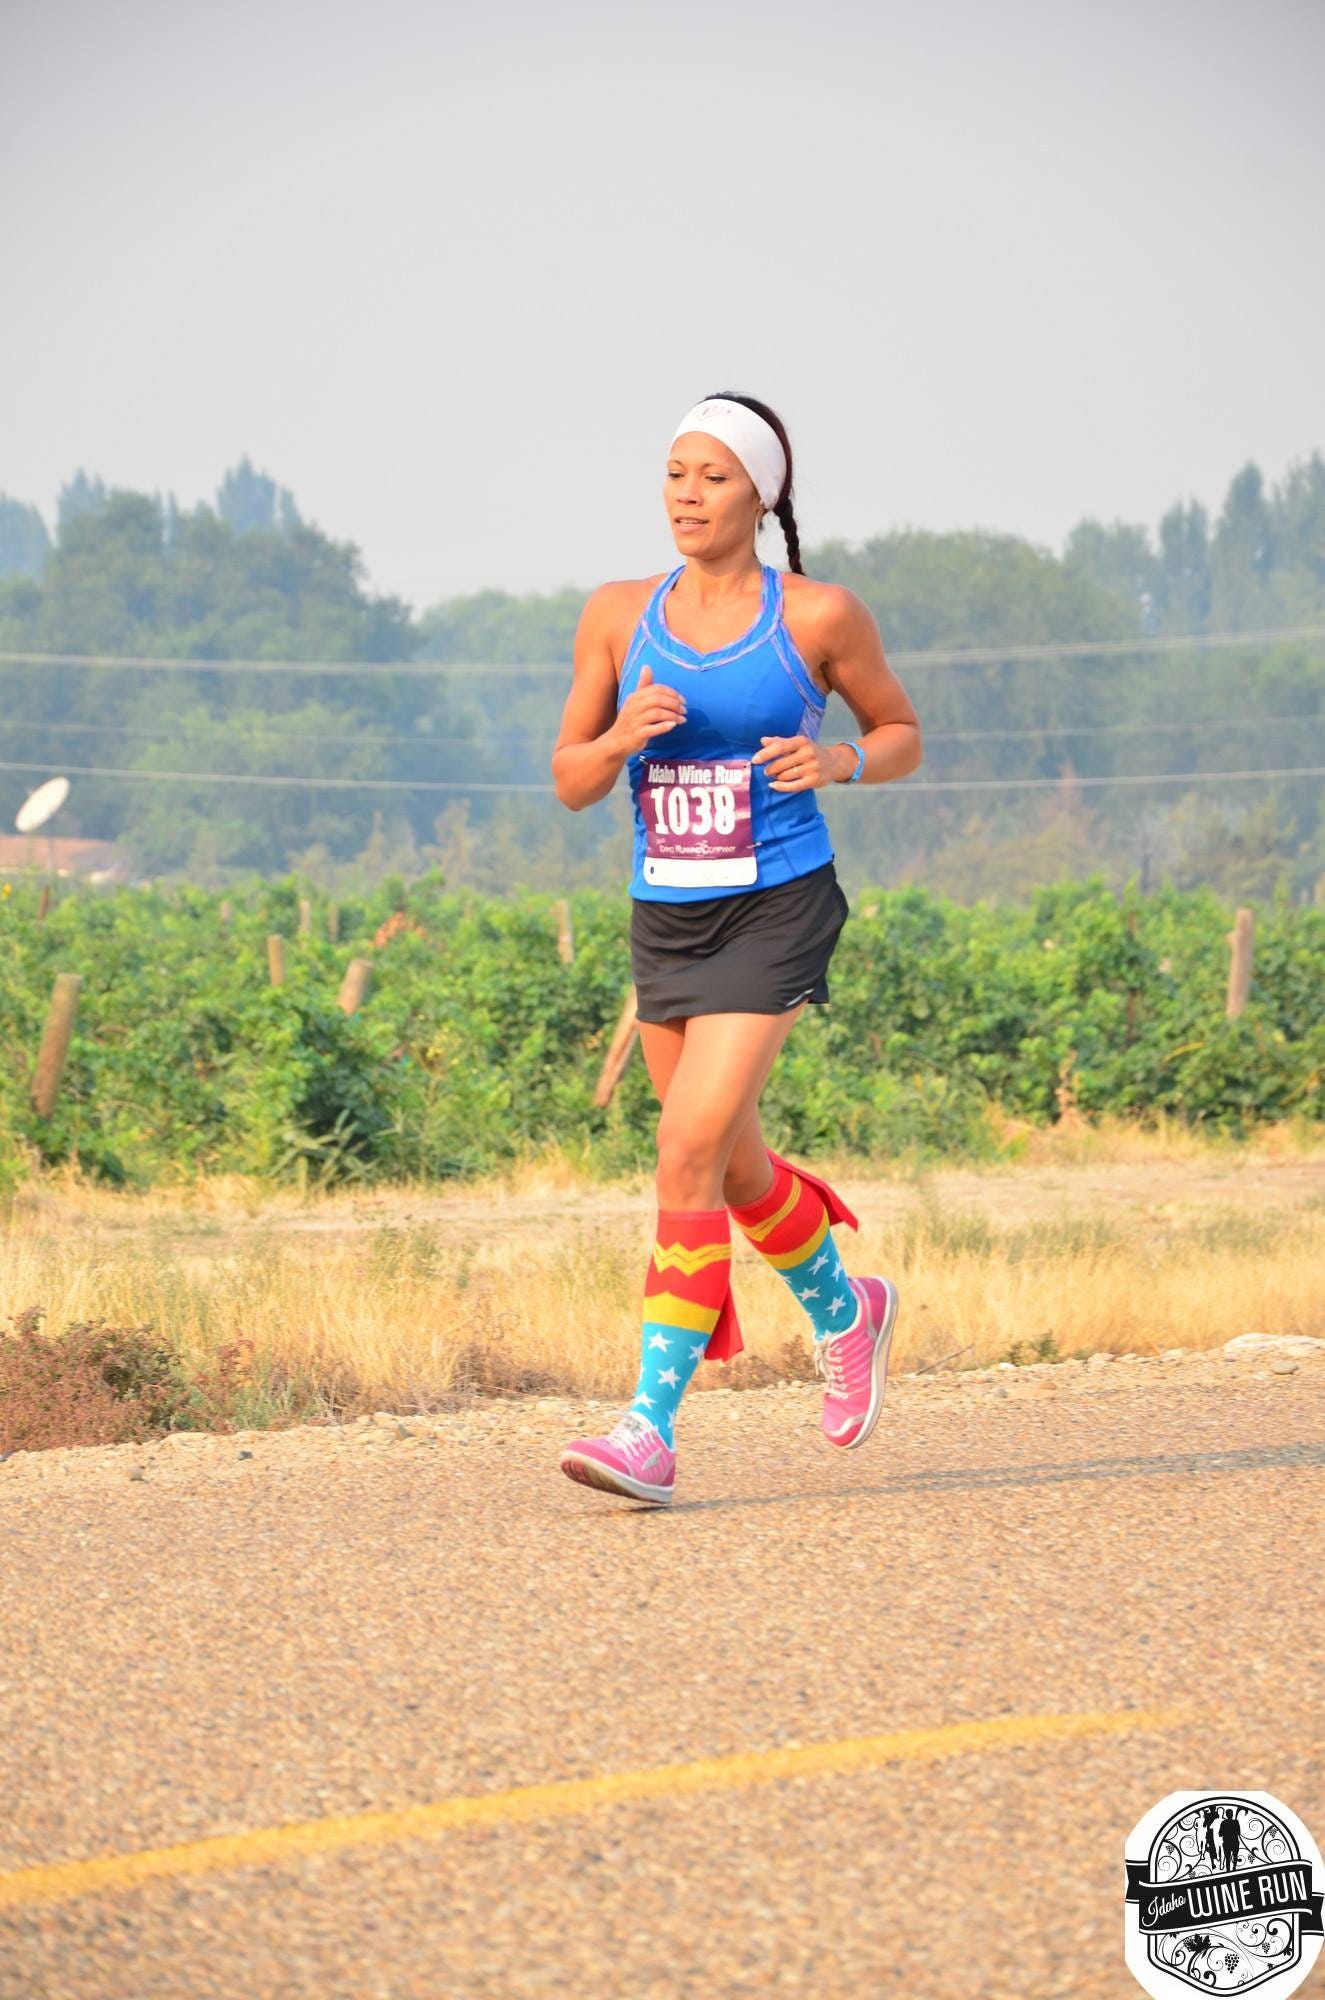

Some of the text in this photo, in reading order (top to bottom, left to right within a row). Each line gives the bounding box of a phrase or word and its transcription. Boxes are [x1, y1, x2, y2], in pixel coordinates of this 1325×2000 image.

[648, 764, 743, 784] Idaho Wine Run
[650, 786, 735, 835] 1038
